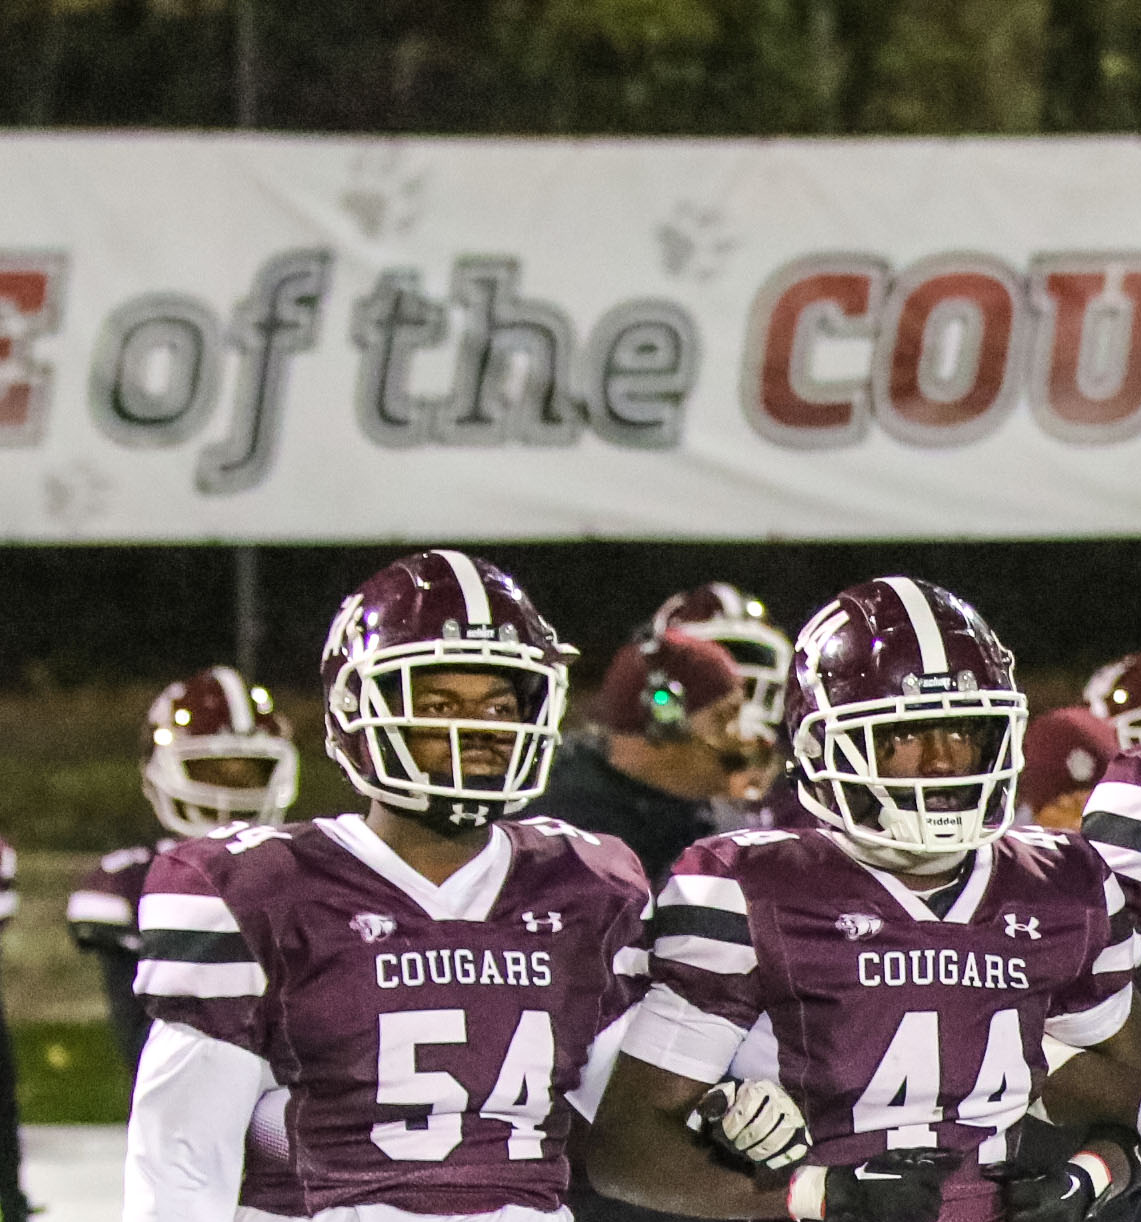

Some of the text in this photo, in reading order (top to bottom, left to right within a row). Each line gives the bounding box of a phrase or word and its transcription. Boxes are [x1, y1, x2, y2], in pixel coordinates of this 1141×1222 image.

[90, 248, 335, 495] of
[350, 254, 699, 452] the
[375, 950, 553, 989] COUGARS
[857, 949, 1030, 990] COUGARS
[369, 1009, 556, 1162] 54
[852, 1009, 1035, 1165] 44
